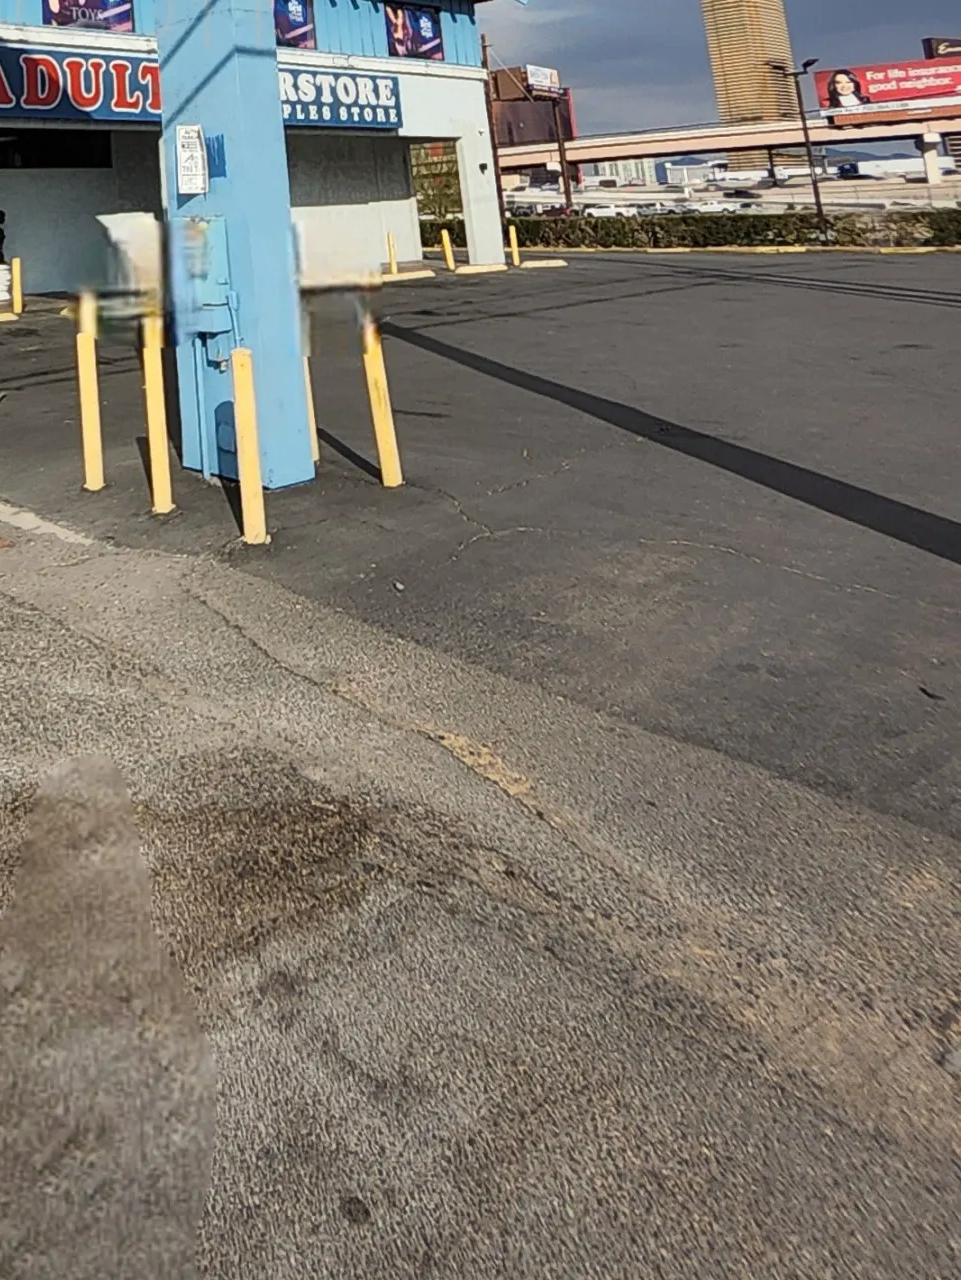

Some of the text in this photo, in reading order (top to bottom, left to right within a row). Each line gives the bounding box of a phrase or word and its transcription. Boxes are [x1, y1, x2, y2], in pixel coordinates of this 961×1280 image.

[278, 72, 396, 106] RSTORE
[282, 103, 399, 123] PLES STORE
